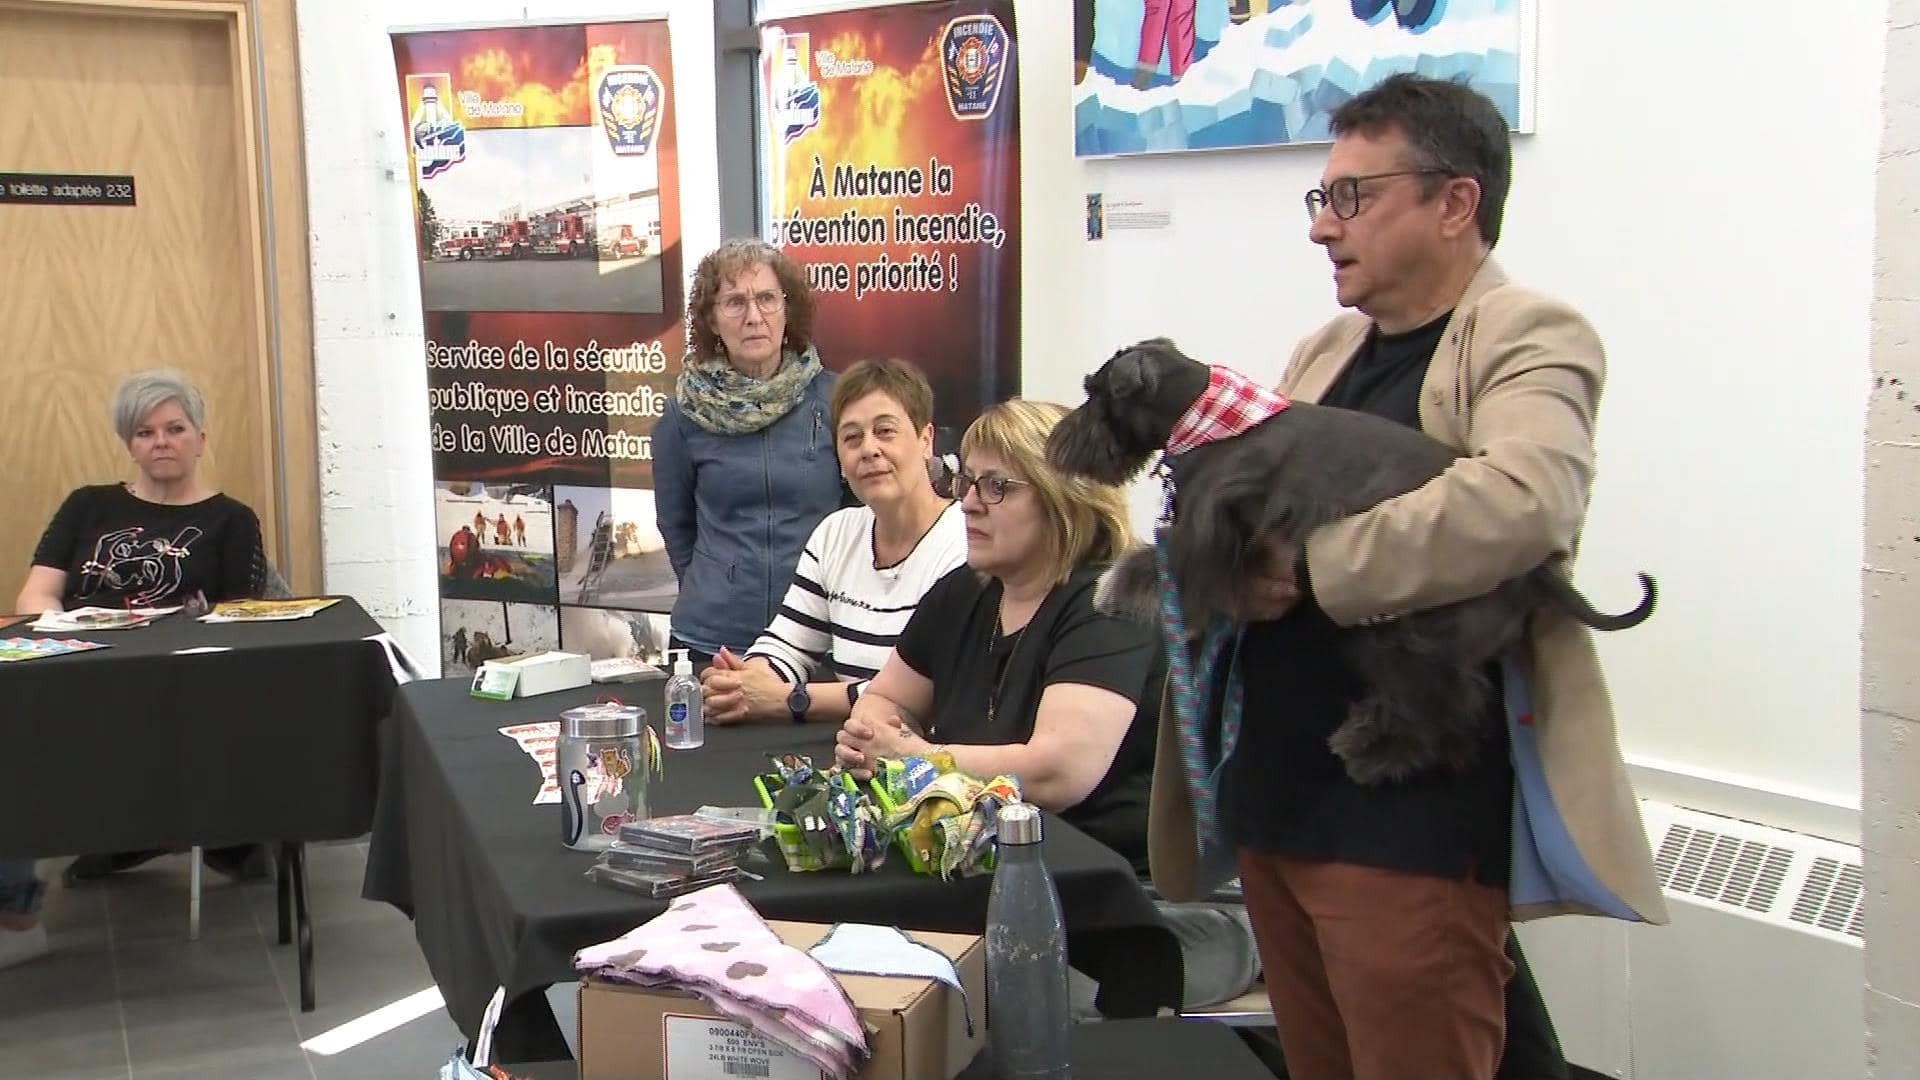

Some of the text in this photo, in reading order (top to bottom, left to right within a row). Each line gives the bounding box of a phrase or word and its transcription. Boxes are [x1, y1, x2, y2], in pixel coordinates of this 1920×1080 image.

[953, 22, 994, 38] INCENDIE
[9, 183, 48, 196] toilette
[52, 183, 102, 199] adaptée
[106, 184, 132, 198] 232
[810, 156, 951, 198] À Matane la
[771, 204, 1005, 249] prévention incendie,
[807, 262, 849, 291] une
[856, 252, 943, 299] priorité
[427, 340, 665, 373] Service de la sécurité
[428, 382, 667, 416] publique et incendie
[431, 424, 653, 459] de la Ville de Matan
